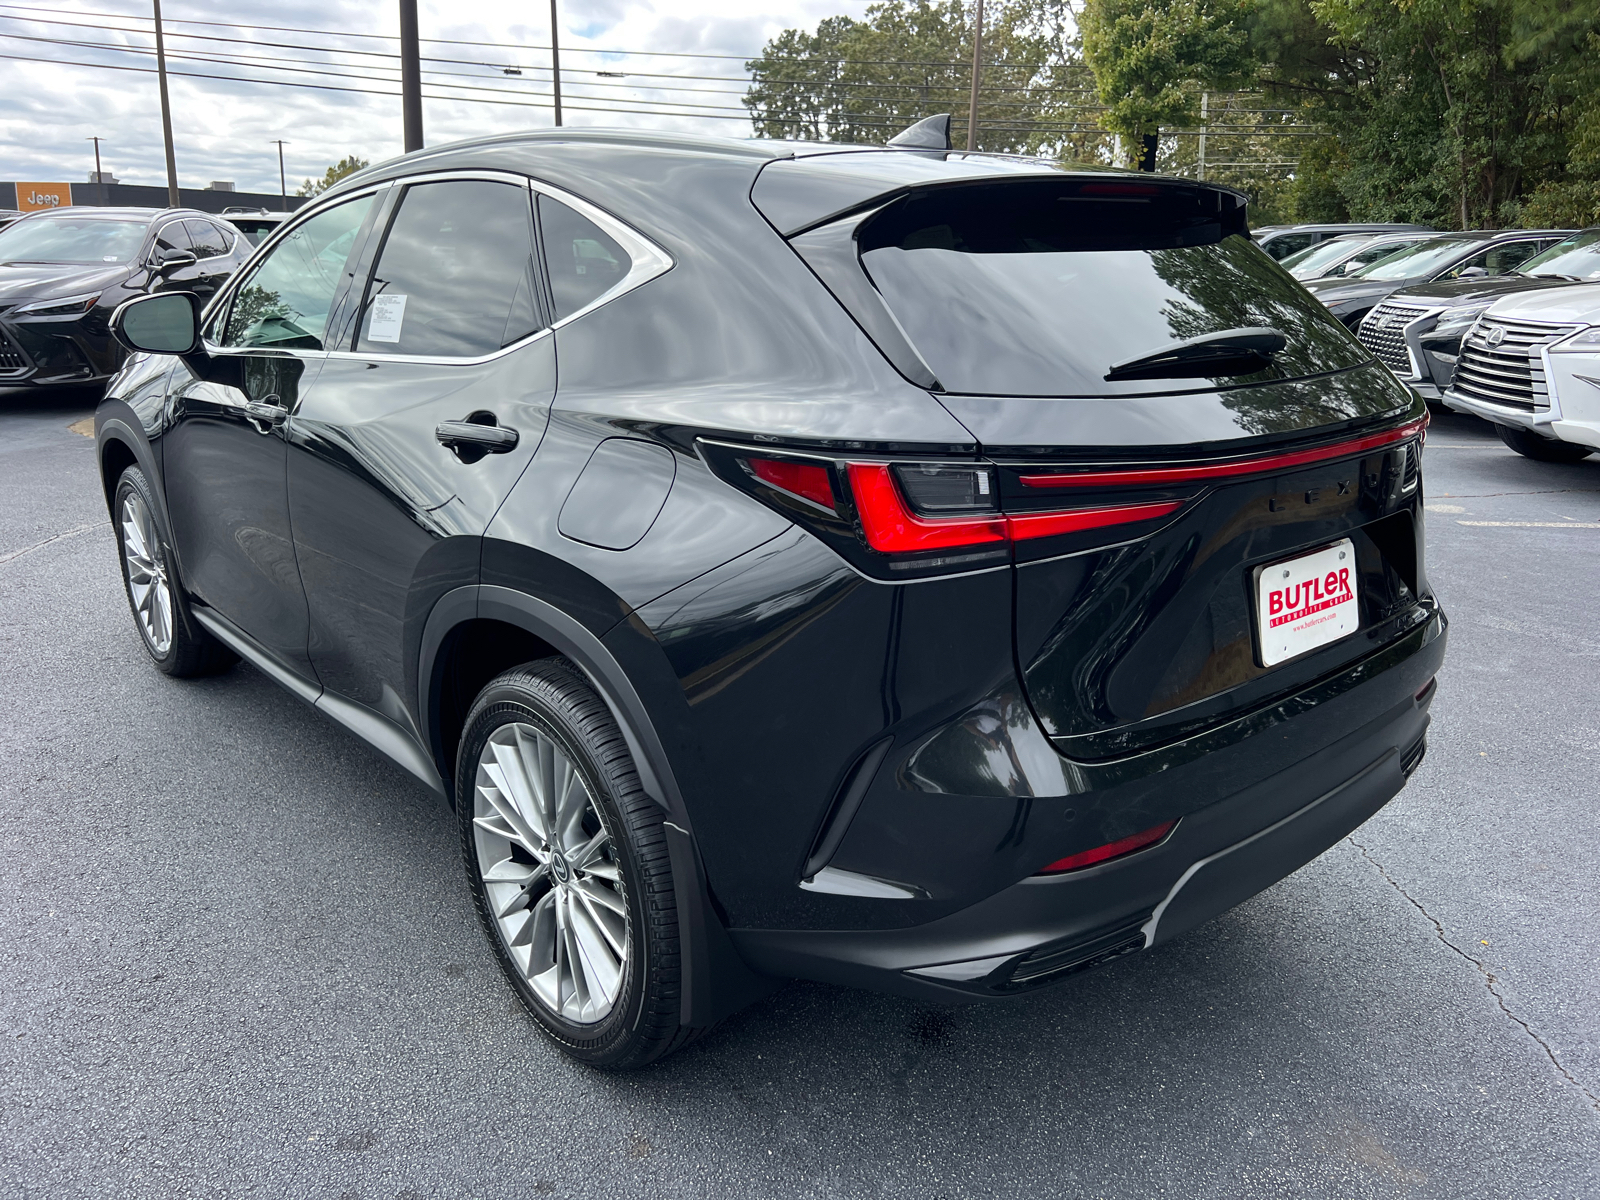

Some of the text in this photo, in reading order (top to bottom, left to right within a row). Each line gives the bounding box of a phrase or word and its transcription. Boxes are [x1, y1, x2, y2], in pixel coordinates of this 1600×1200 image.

[27, 190, 60, 207] Jeep
[1270, 592, 1352, 628] AUTOMOTIVE GROUP
[1293, 612, 1337, 632] www.butlercars.com
